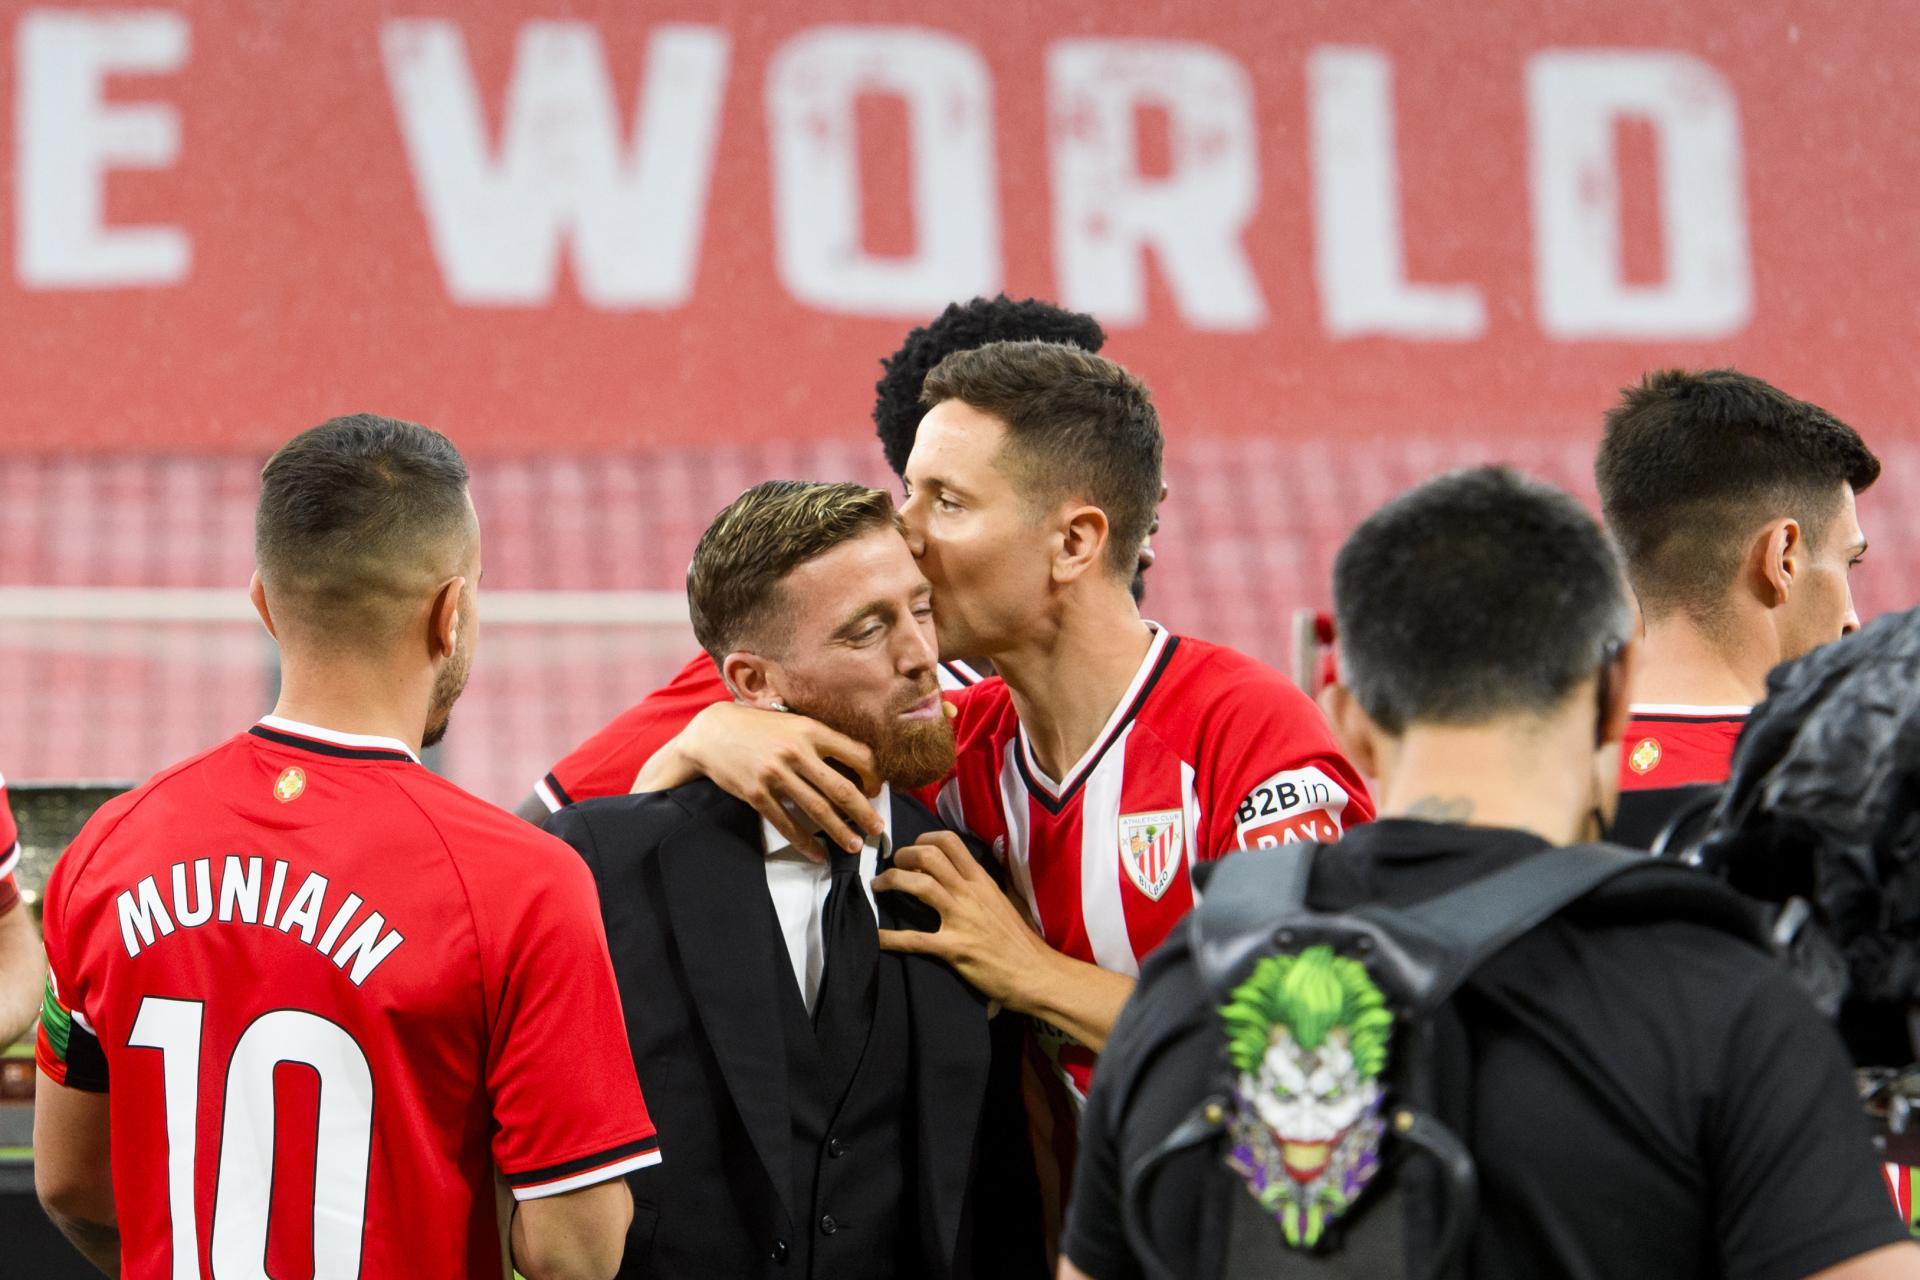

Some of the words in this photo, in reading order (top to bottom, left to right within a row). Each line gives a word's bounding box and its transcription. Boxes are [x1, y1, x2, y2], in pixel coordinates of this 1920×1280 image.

[14, 9, 194, 291] E
[379, 17, 1754, 342] WORLD
[1123, 815, 1159, 825] ATHLETIC
[1160, 812, 1180, 822] CLUB
[1138, 870, 1169, 896] BILBAO
[116, 854, 406, 988] MUNIAIN
[126, 995, 376, 1280] 10
